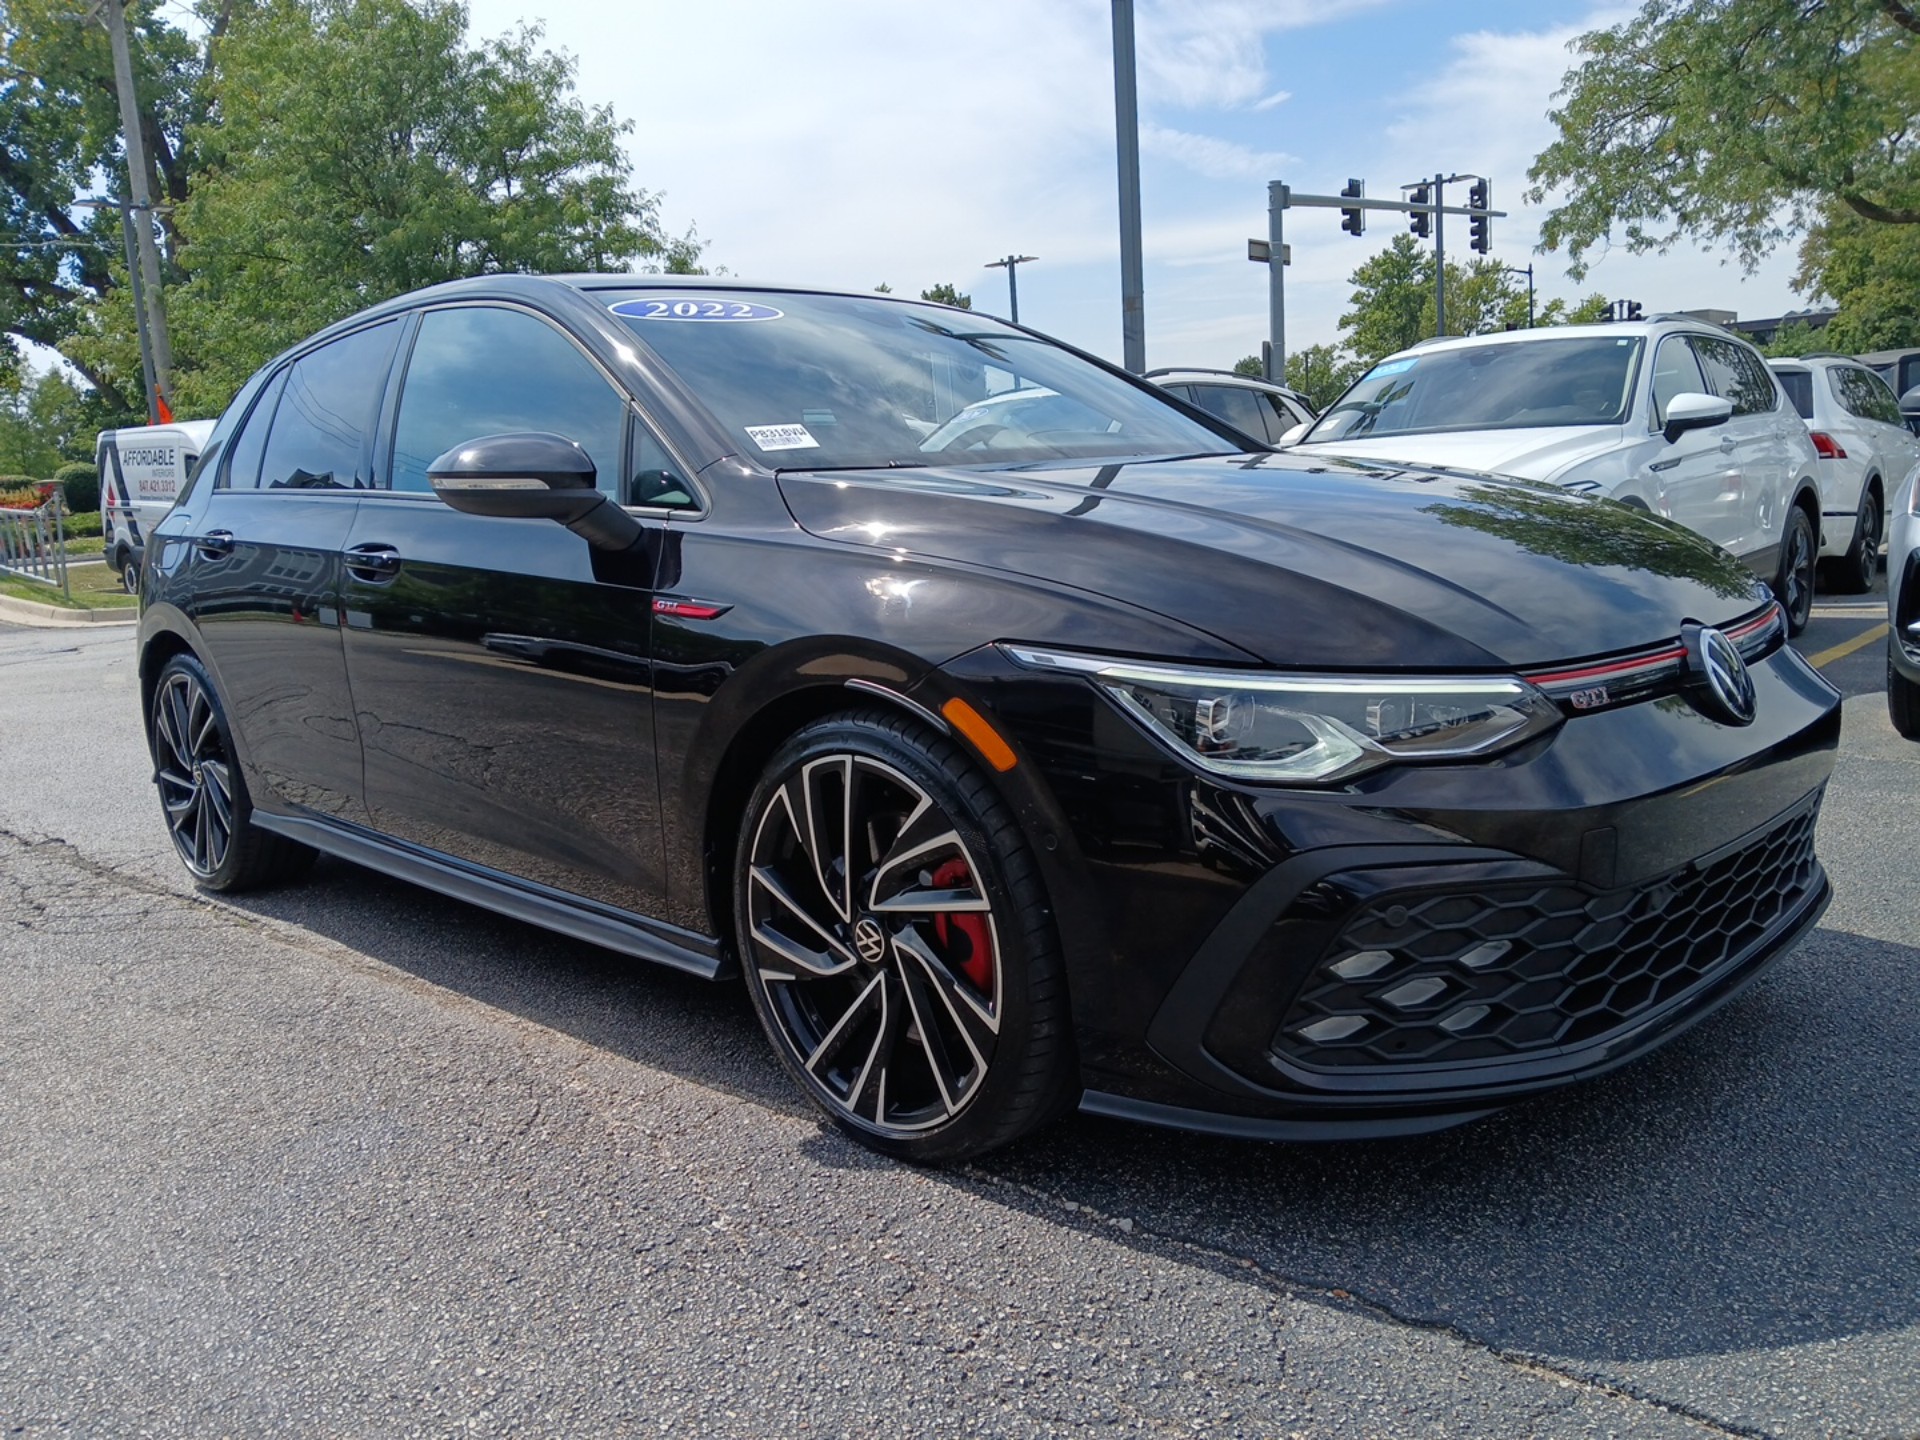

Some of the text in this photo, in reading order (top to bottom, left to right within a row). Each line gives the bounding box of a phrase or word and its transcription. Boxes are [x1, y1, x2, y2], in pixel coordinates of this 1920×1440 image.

[645, 302, 754, 318] 2022
[122, 449, 175, 466] AFFORDABLE
[656, 600, 679, 610] GTI
[1570, 686, 1611, 709] GTI
